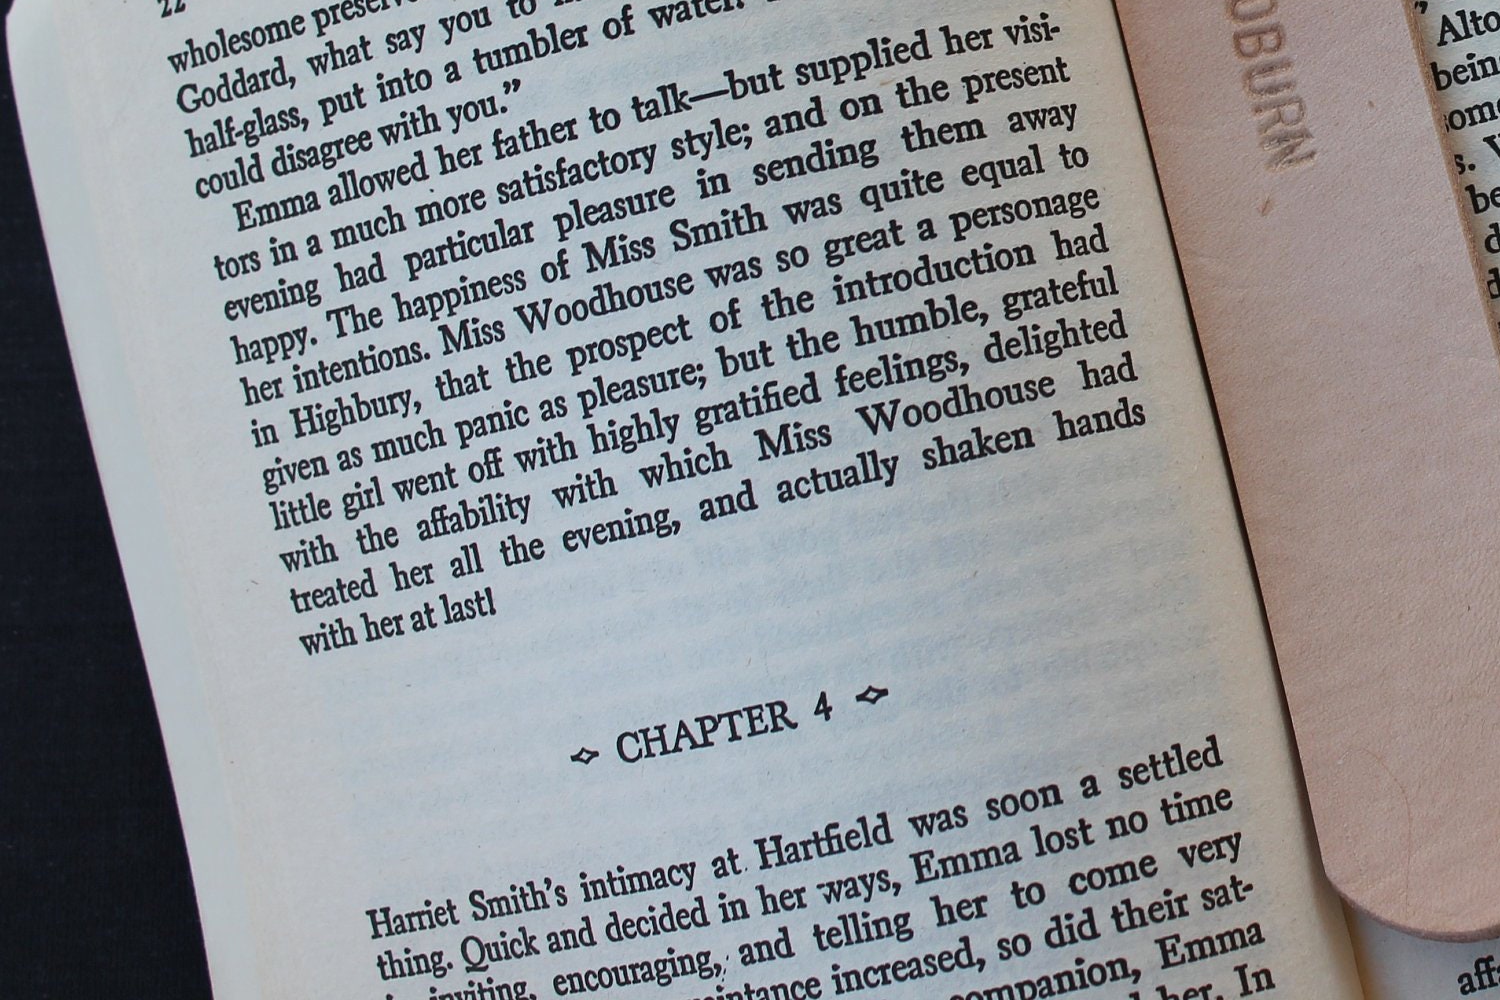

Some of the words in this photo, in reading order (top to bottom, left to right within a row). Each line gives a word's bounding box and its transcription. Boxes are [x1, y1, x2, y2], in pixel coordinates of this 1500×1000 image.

[166, 14, 306, 74] wholesome
[176, 55, 297, 114] Goddard,
[305, 34, 374, 77] what
[384, 23, 426, 55] say
[437, 5, 493, 46] you
[231, 190, 322, 233] Emma
[327, 149, 430, 207] allowed
[433, 143, 484, 176] her
[491, 117, 579, 161] father
[588, 106, 622, 135] to
[794, 28, 933, 86] supplied
[938, 24, 994, 57] her
[1002, 11, 1061, 46] visi-
[195, 151, 266, 200] could
[271, 129, 374, 177] disagree
[376, 104, 442, 147] with
[223, 277, 323, 322] evening
[333, 251, 388, 293] had
[402, 217, 535, 283] particular
[552, 185, 677, 243] pleasure
[695, 167, 732, 200] in
[752, 138, 880, 186] sending
[900, 118, 988, 153] them
[1006, 103, 1078, 134] away
[262, 455, 330, 496] given
[336, 446, 364, 472] as
[370, 418, 448, 463] much
[453, 399, 530, 451] panic
[538, 395, 568, 422] as
[576, 362, 707, 420] pleasure;
[714, 339, 776, 378] but
[785, 326, 841, 362] the
[848, 293, 990, 347] humble,
[1001, 264, 1120, 322] grateful
[278, 533, 340, 573] with
[355, 522, 400, 555] the
[416, 492, 531, 542] affability
[551, 467, 619, 510] with
[638, 440, 734, 489] which
[752, 421, 833, 462] Miss
[854, 375, 1056, 436] Woodhouse
[1076, 350, 1139, 391] had
[298, 617, 359, 657] with
[359, 611, 406, 643] her
[409, 601, 438, 633] at
[438, 586, 497, 625] last!
[616, 700, 798, 763] CHAPTER
[814, 691, 834, 722] 4
[364, 898, 461, 940] Harriet
[579, 861, 697, 903] intimacy
[710, 847, 743, 880] at
[752, 811, 895, 871] Hartfield
[907, 804, 969, 839] was
[985, 783, 1064, 822] soon
[1079, 774, 1102, 800] a
[1117, 733, 1224, 790] settled
